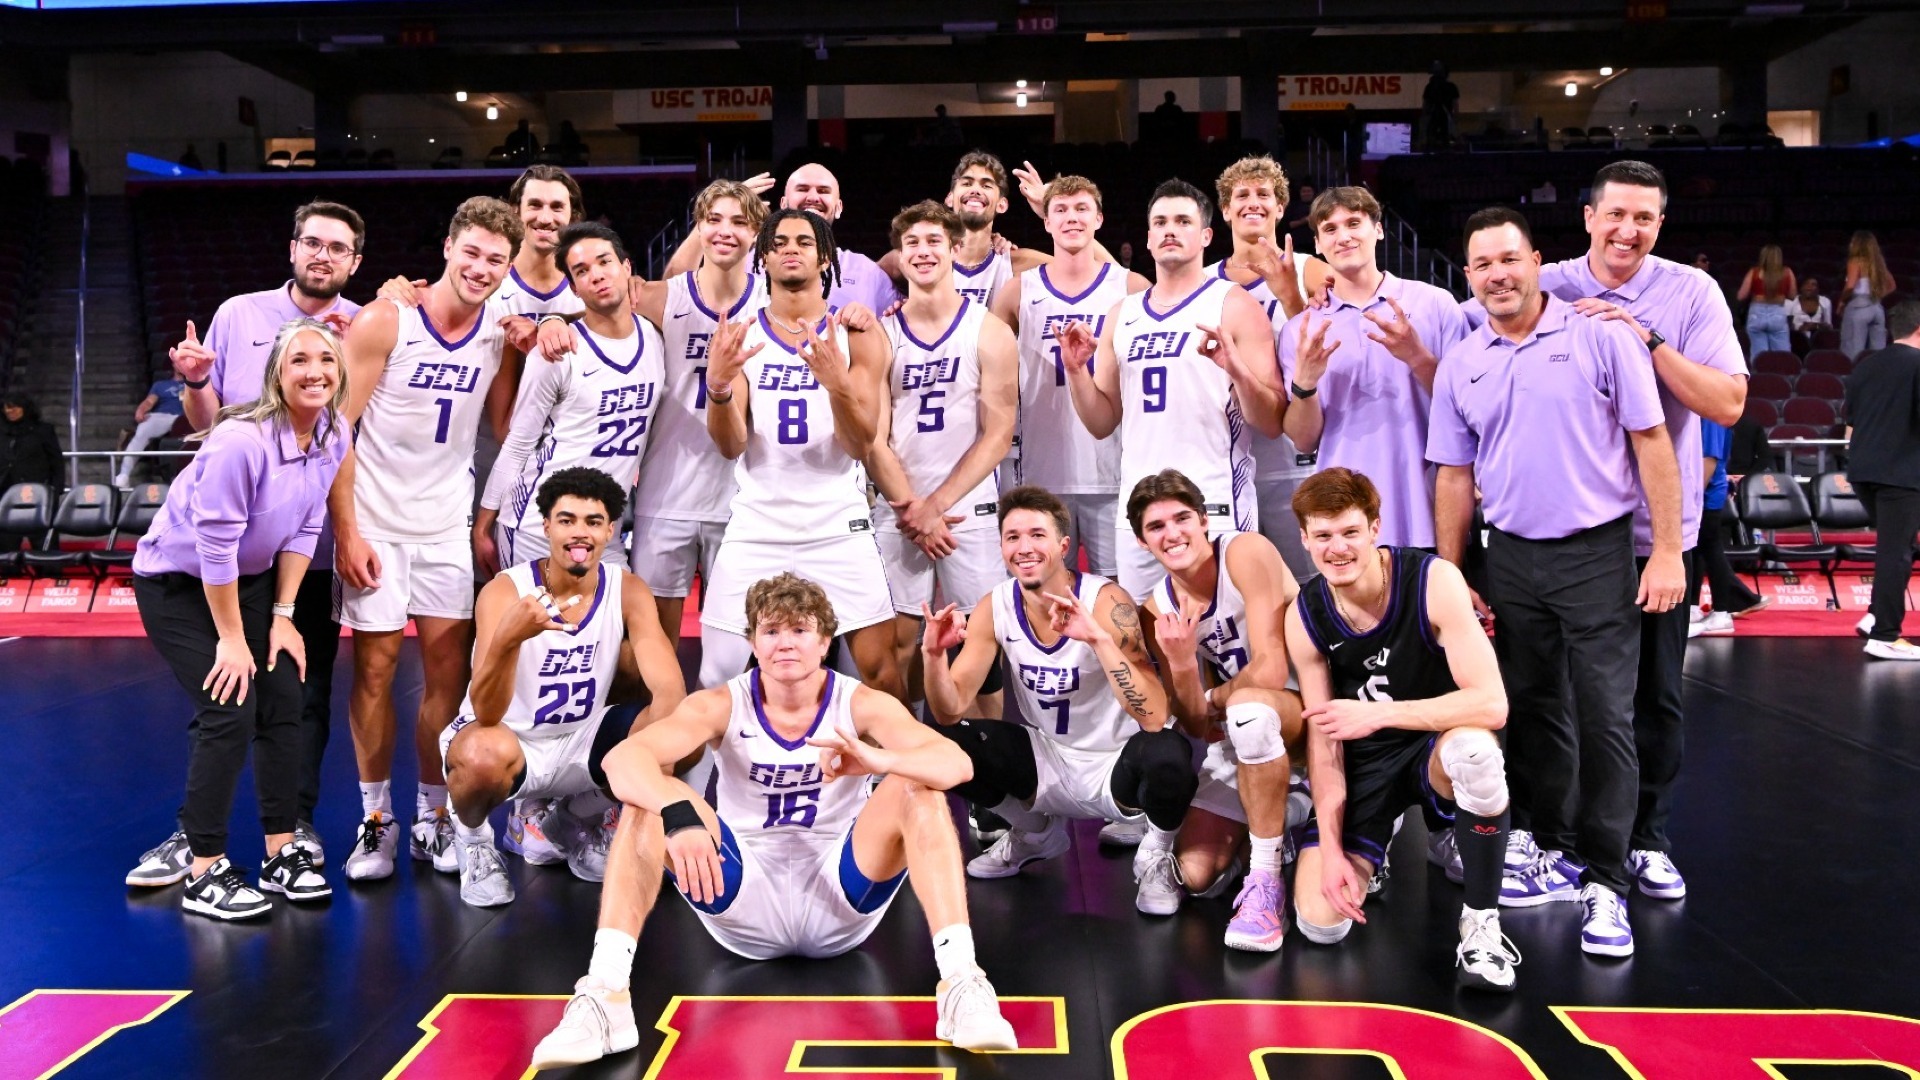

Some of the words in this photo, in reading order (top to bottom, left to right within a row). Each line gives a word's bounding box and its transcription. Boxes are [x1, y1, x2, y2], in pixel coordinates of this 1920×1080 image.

[1017, 18, 1054, 30] 110
[651, 90, 694, 108] USC
[702, 87, 772, 108] TROJA
[1294, 75, 1402, 95] TROJANS
[1128, 332, 1191, 363] GCU
[1549, 353, 1570, 362] GCU
[408, 362, 481, 393] GCU
[694, 366, 708, 409] 1
[758, 363, 820, 391] GCU
[902, 356, 961, 391] GCU
[1142, 365, 1167, 413] 9
[597, 382, 654, 417] GCU
[917, 390, 946, 433] 5
[434, 398, 453, 443] 1
[590, 415, 648, 457] 22
[778, 398, 808, 444] 8
[41, 597, 77, 606] FARGO
[43, 587, 79, 597] WELLS
[108, 597, 137, 606] FARG
[111, 587, 135, 596] WEL
[1774, 585, 1816, 594] WELLS
[1777, 595, 1819, 605] FARGO
[538, 641, 600, 677] GCU
[1019, 663, 1080, 695] GCU
[534, 678, 596, 726] 23
[1038, 698, 1071, 734] 7
[749, 762, 823, 788] GCU
[762, 788, 821, 829] 16
